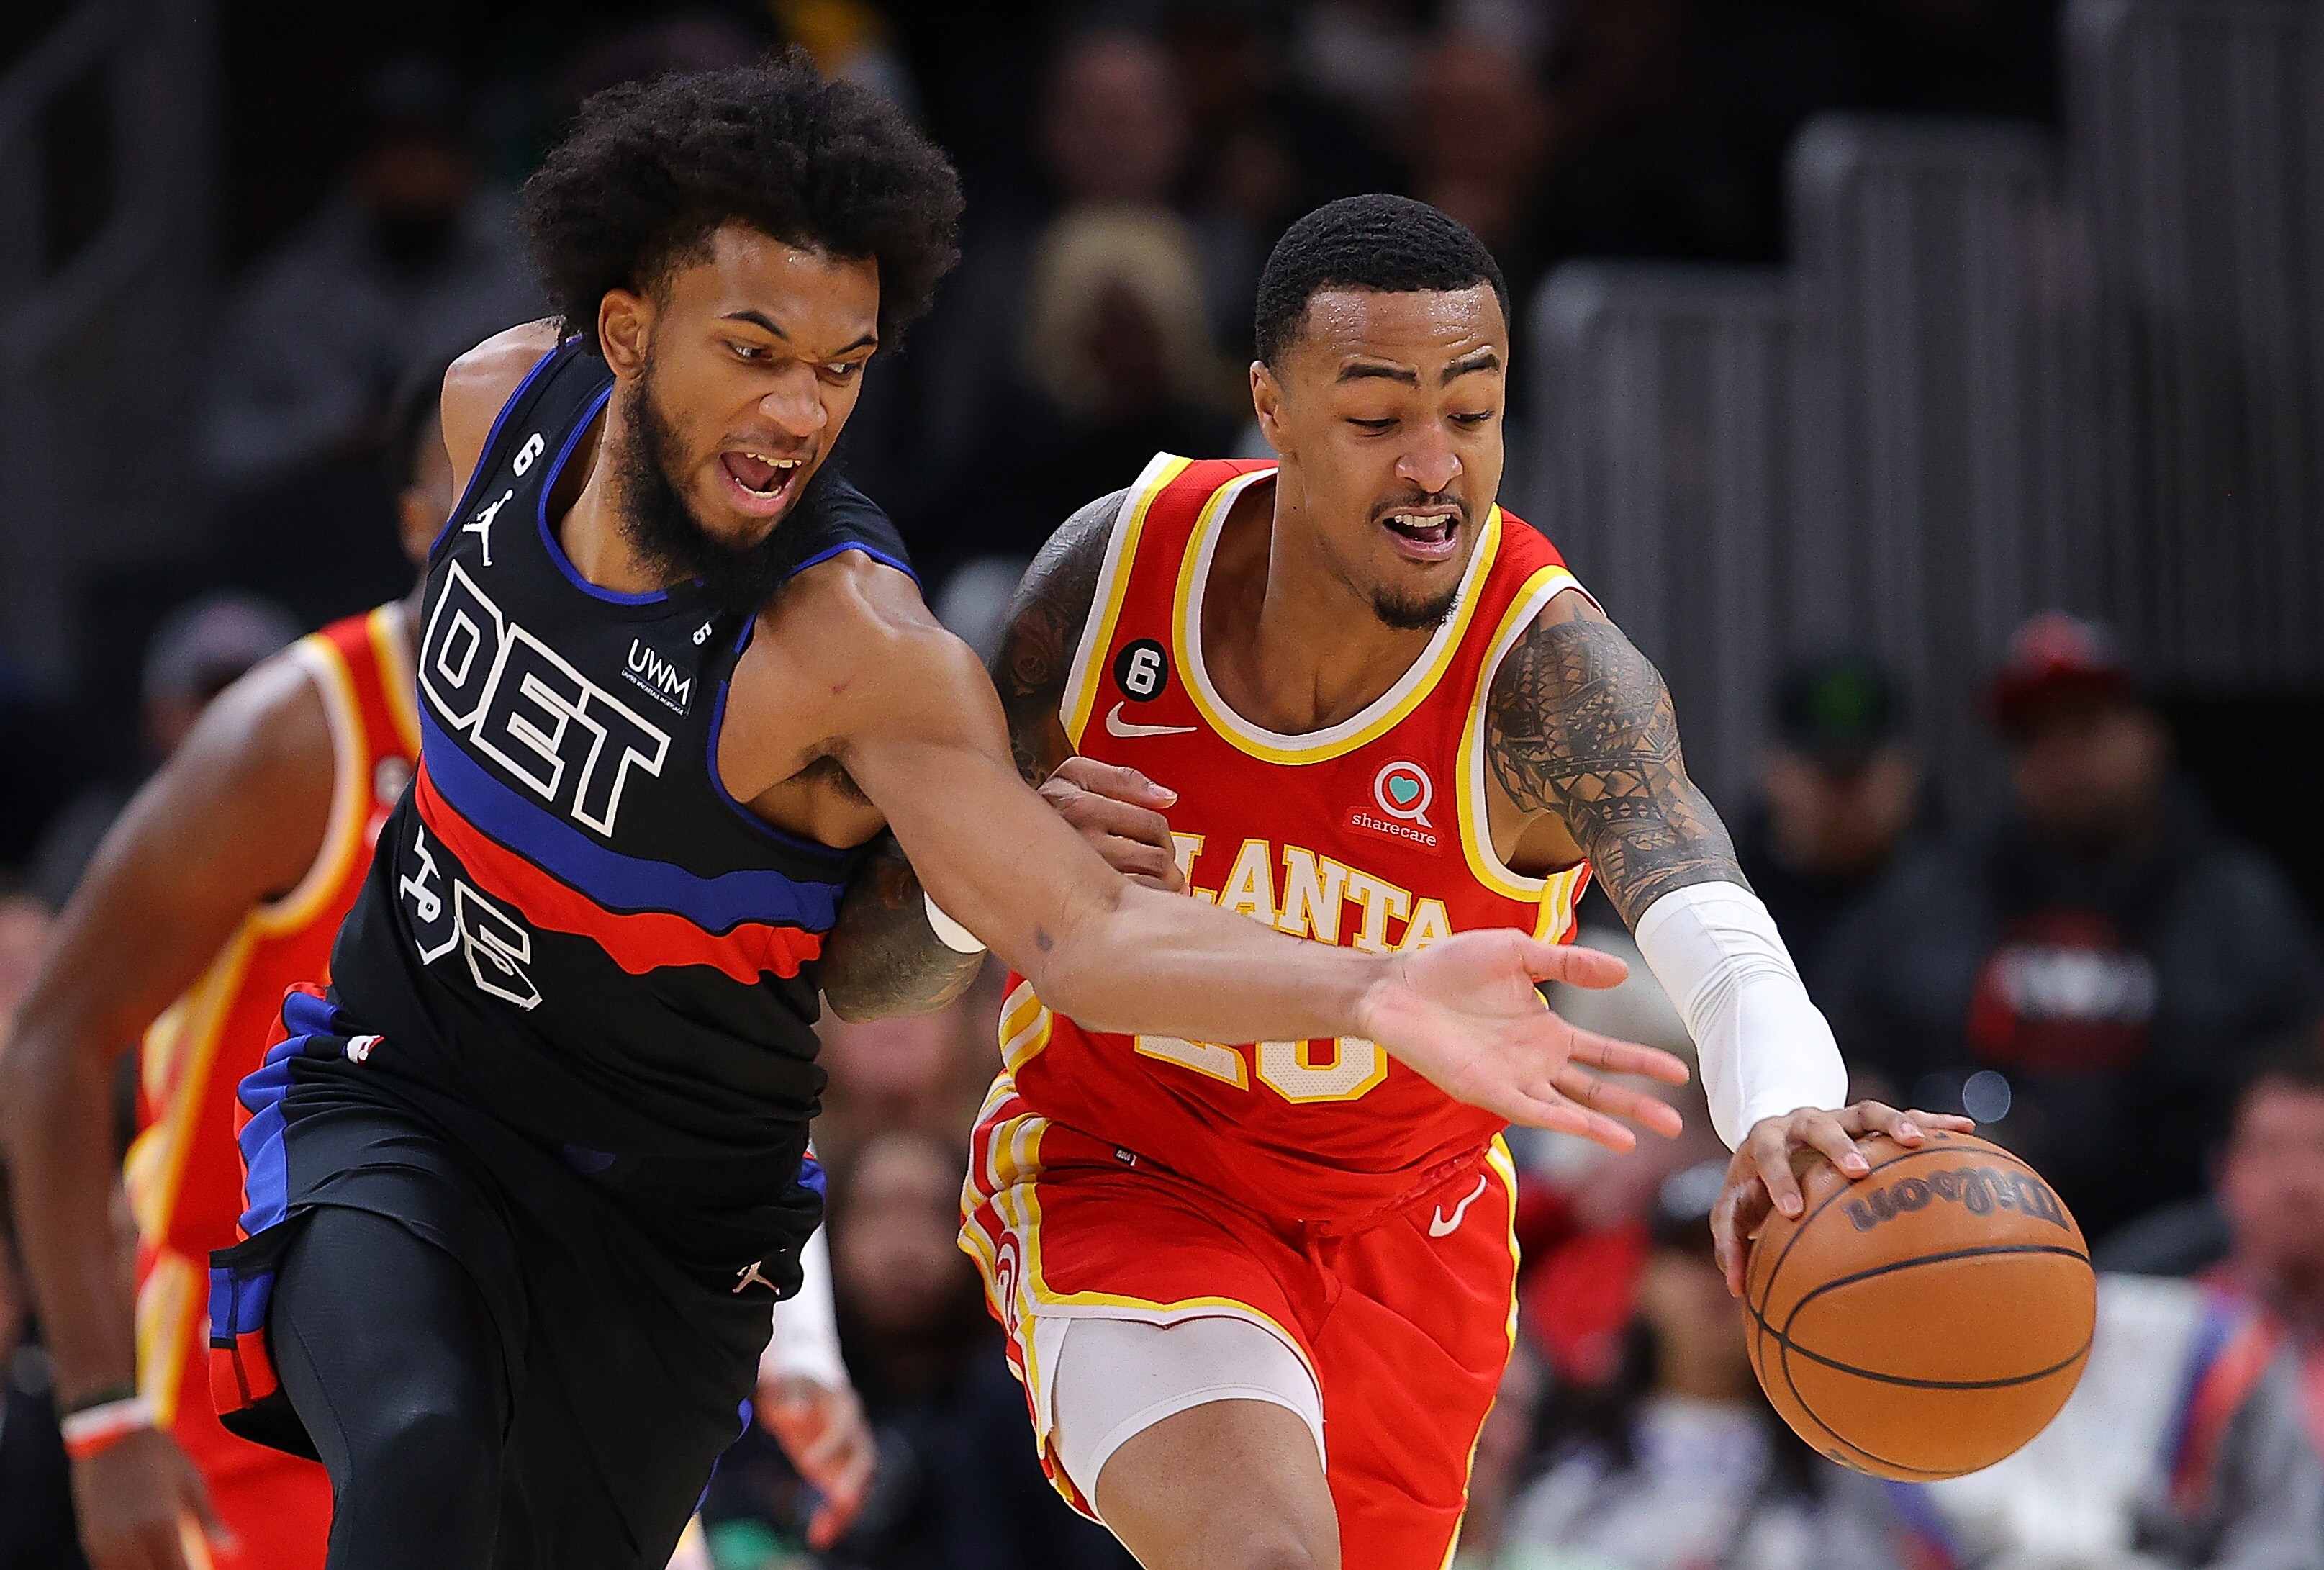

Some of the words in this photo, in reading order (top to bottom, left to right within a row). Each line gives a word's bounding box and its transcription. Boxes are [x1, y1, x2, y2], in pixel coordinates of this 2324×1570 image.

[512, 433, 545, 477] 6
[418, 559, 672, 838] DET
[628, 638, 692, 706] UWM
[1126, 648, 1162, 695] 6
[1352, 813, 1437, 847] sharecare
[1170, 831, 1454, 955] LANTA
[1843, 1167, 2071, 1232] Wilson
